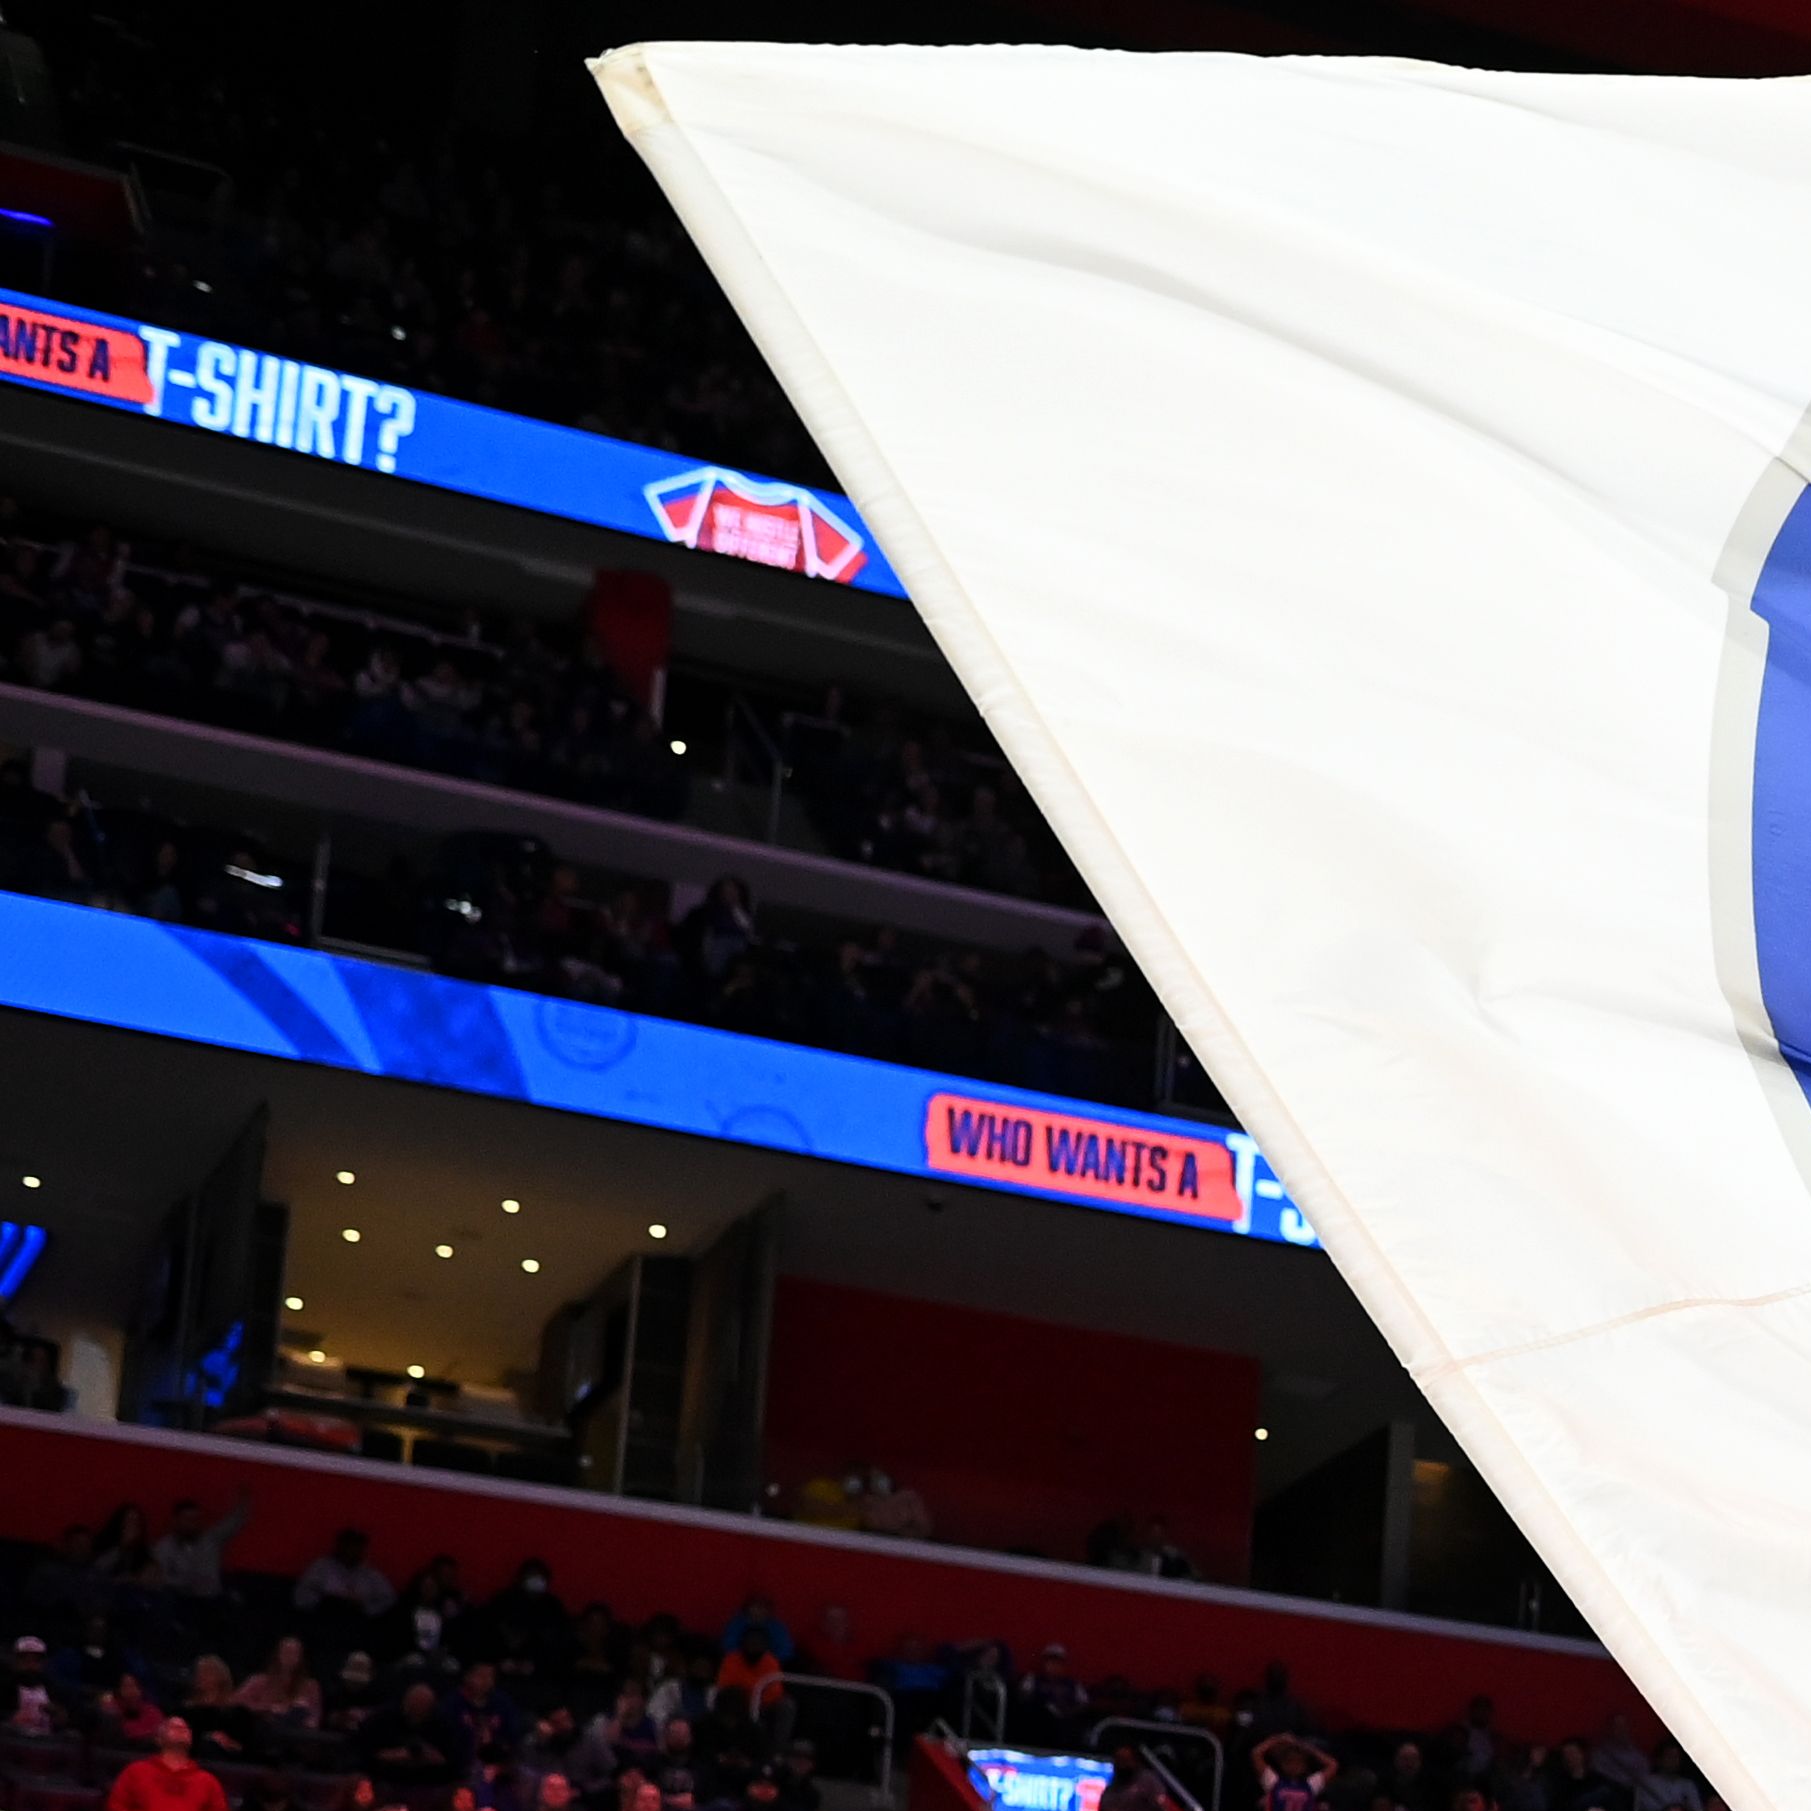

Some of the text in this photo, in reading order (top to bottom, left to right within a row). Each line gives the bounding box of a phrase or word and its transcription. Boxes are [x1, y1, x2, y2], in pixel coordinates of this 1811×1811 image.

[0, 314, 416, 474] ANTS A T-SHIRT?
[948, 1106, 1032, 1167] WHO
[1046, 1125, 1167, 1192] WANTS
[1178, 1152, 1199, 1198] A
